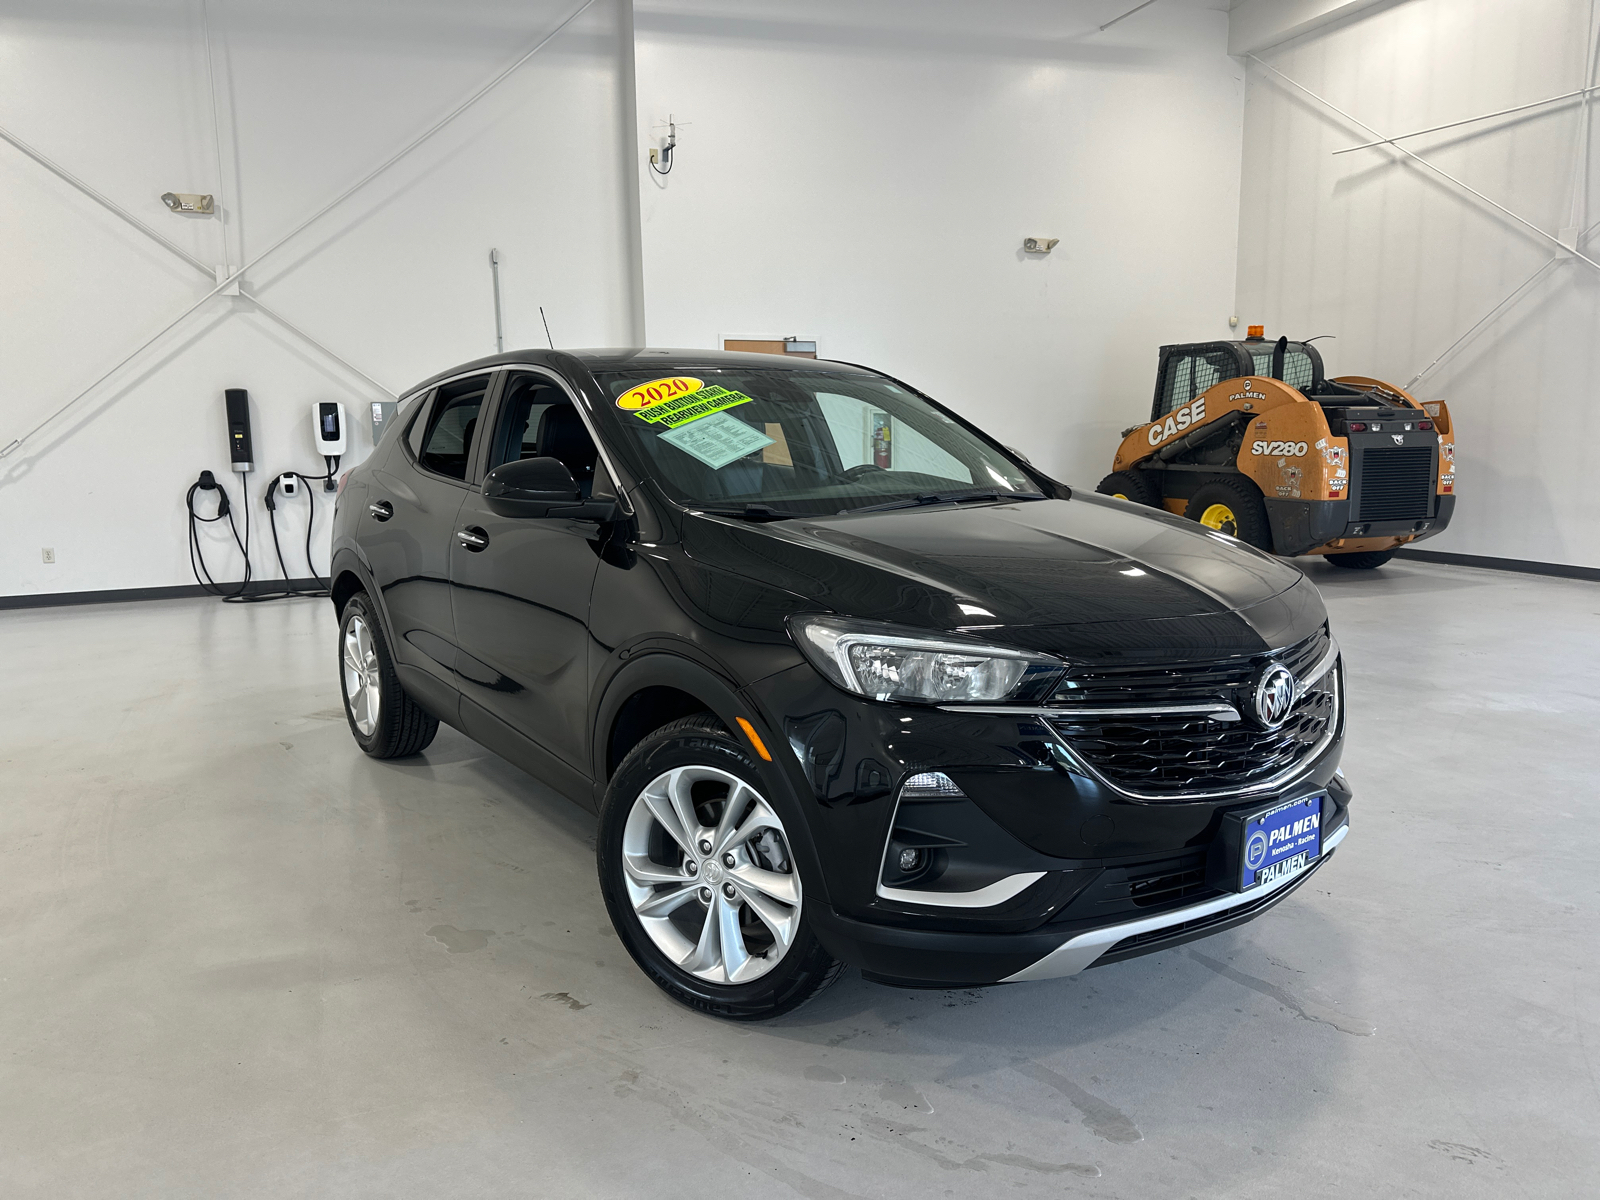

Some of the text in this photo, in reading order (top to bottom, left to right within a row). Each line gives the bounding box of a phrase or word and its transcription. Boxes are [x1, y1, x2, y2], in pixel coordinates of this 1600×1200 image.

[632, 379, 689, 407] 2020
[638, 386, 727, 421] PUSH BUTTON START
[660, 393, 745, 426] REARVIEW CAMERA
[1229, 392, 1266, 401] PALMEN
[1148, 397, 1206, 446] CASE
[1251, 440, 1308, 457] SV280
[1269, 813, 1320, 846] PALMEN
[1271, 842, 1294, 857] Kenosha
[1297, 834, 1315, 846] Racine
[1261, 852, 1306, 885] PALMEN
